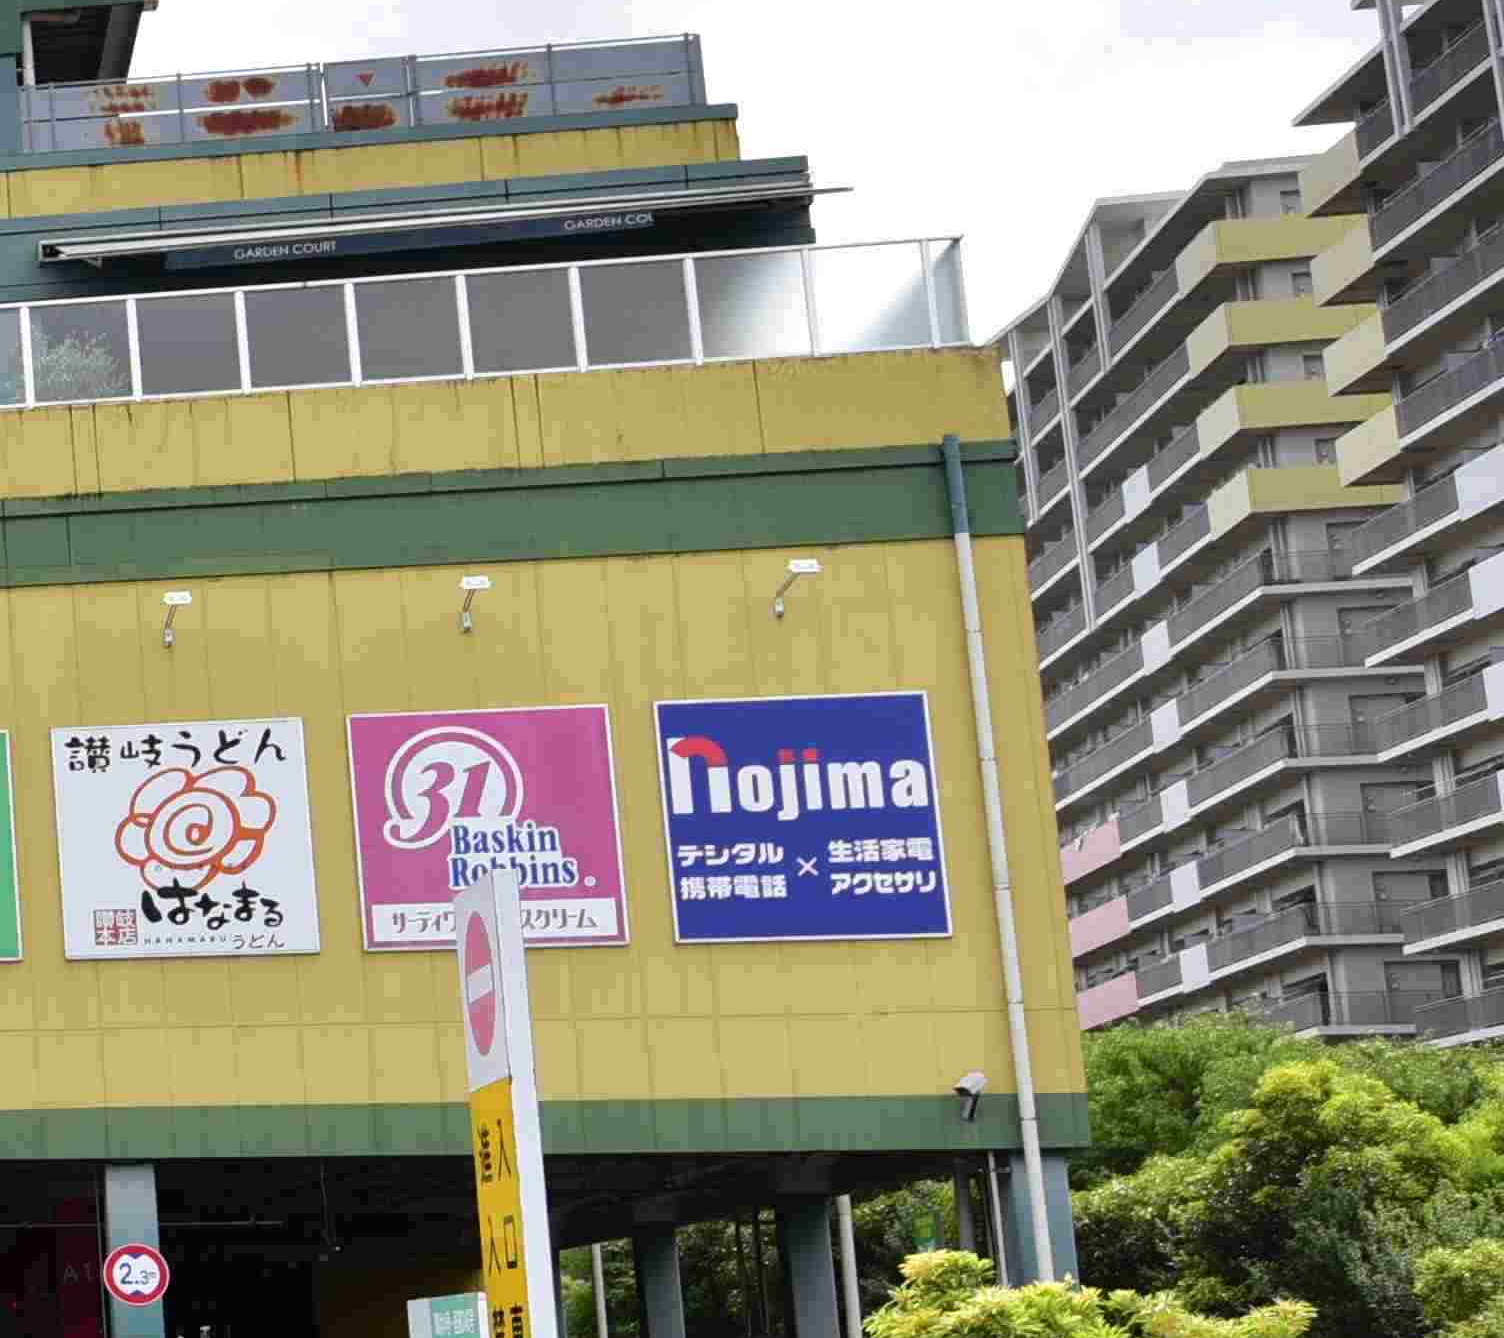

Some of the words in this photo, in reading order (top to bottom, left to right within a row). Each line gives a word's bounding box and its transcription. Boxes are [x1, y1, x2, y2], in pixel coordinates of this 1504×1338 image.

[234, 244, 288, 260] GARDEN
[292, 240, 336, 254] COURT
[64, 728, 287, 773] 讃岐うどん
[666, 735, 928, 821] nojima
[453, 821, 557, 855] Baskin
[828, 837, 935, 864] 生活家電
[680, 874, 788, 901] 携帯電話
[829, 870, 937, 896] アクセサリ
[141, 878, 283, 930] はなまる
[232, 934, 284, 949] うどん
